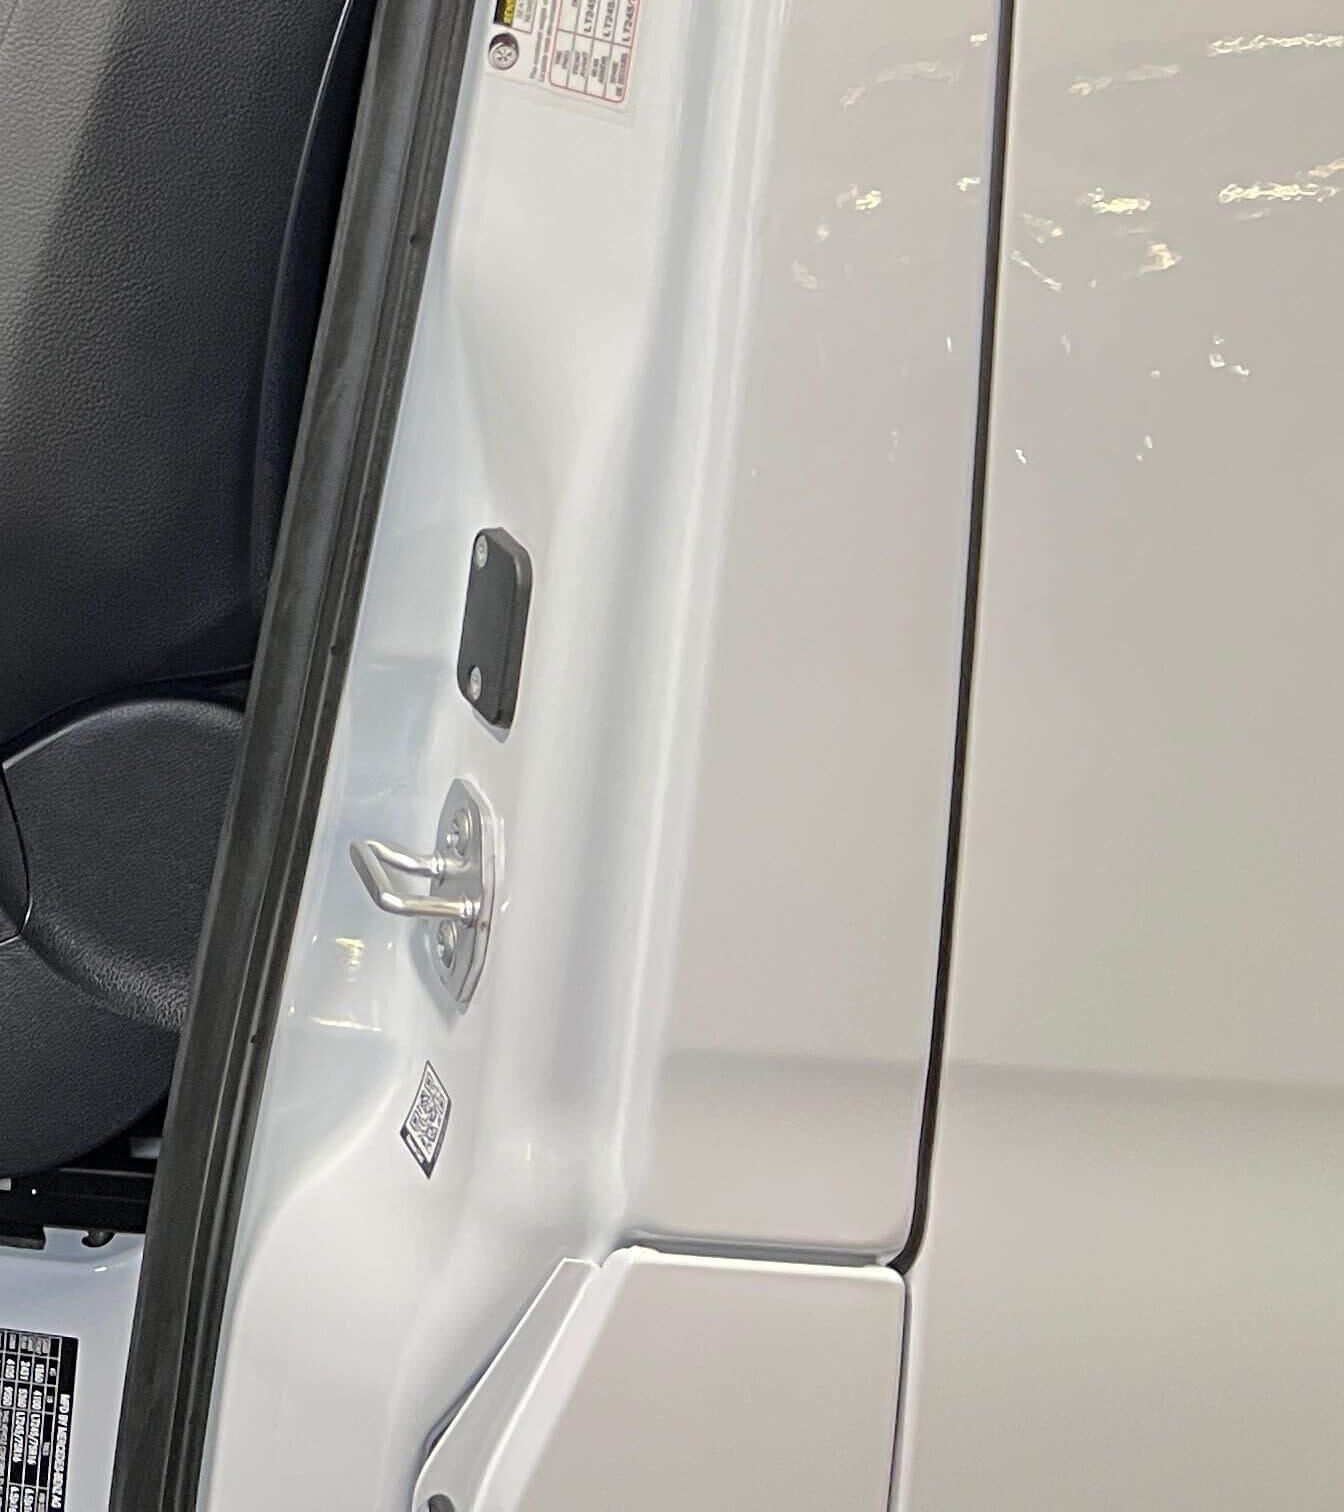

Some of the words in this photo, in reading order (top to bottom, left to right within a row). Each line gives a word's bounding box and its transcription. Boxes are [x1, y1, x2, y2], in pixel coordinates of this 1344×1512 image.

[11, 1410, 25, 1463] LT245/75R16
[26, 1413, 40, 1465] LT245/75R16
[50, 1495, 61, 1508] AG
